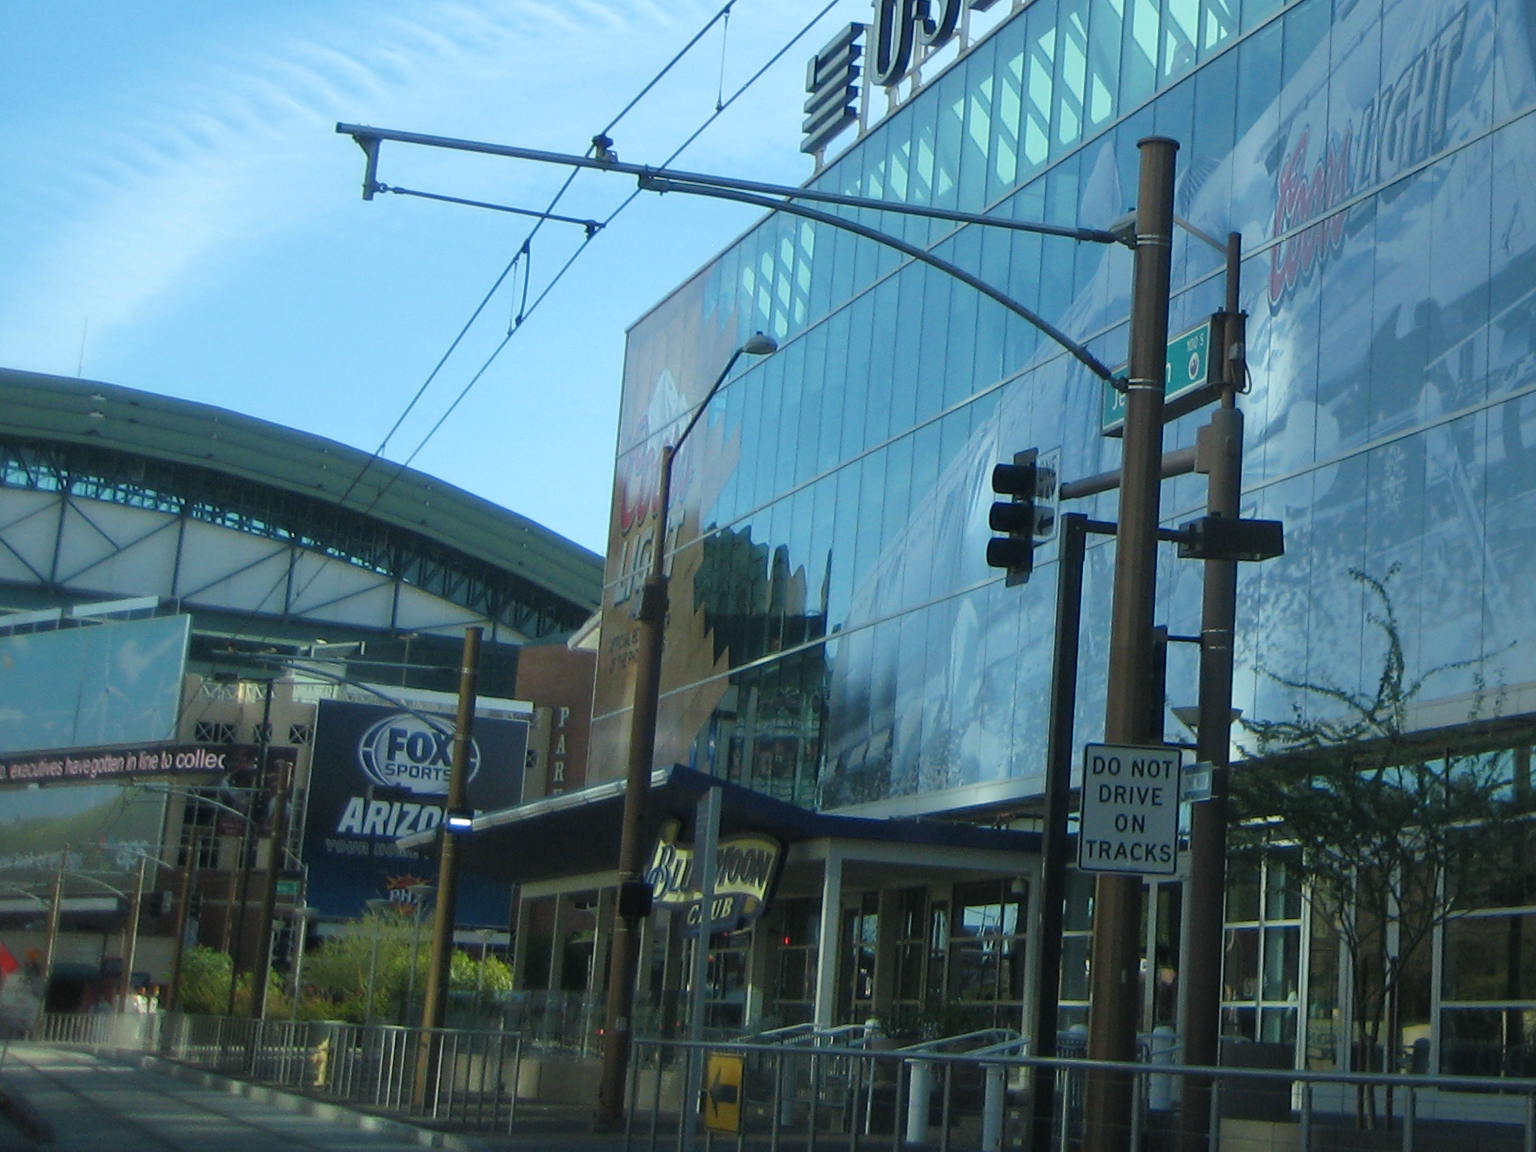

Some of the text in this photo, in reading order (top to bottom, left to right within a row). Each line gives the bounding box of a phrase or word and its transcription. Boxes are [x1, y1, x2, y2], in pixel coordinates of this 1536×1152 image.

[126, 751, 137, 771] in
[161, 750, 173, 769] to
[552, 705, 571, 795] PAR
[1092, 755, 1174, 779] DO NOT
[1098, 783, 1164, 806] DRIVE
[337, 797, 483, 838] ARIZO
[1114, 813, 1146, 833] ON
[1085, 839, 1172, 863] TRACKS
